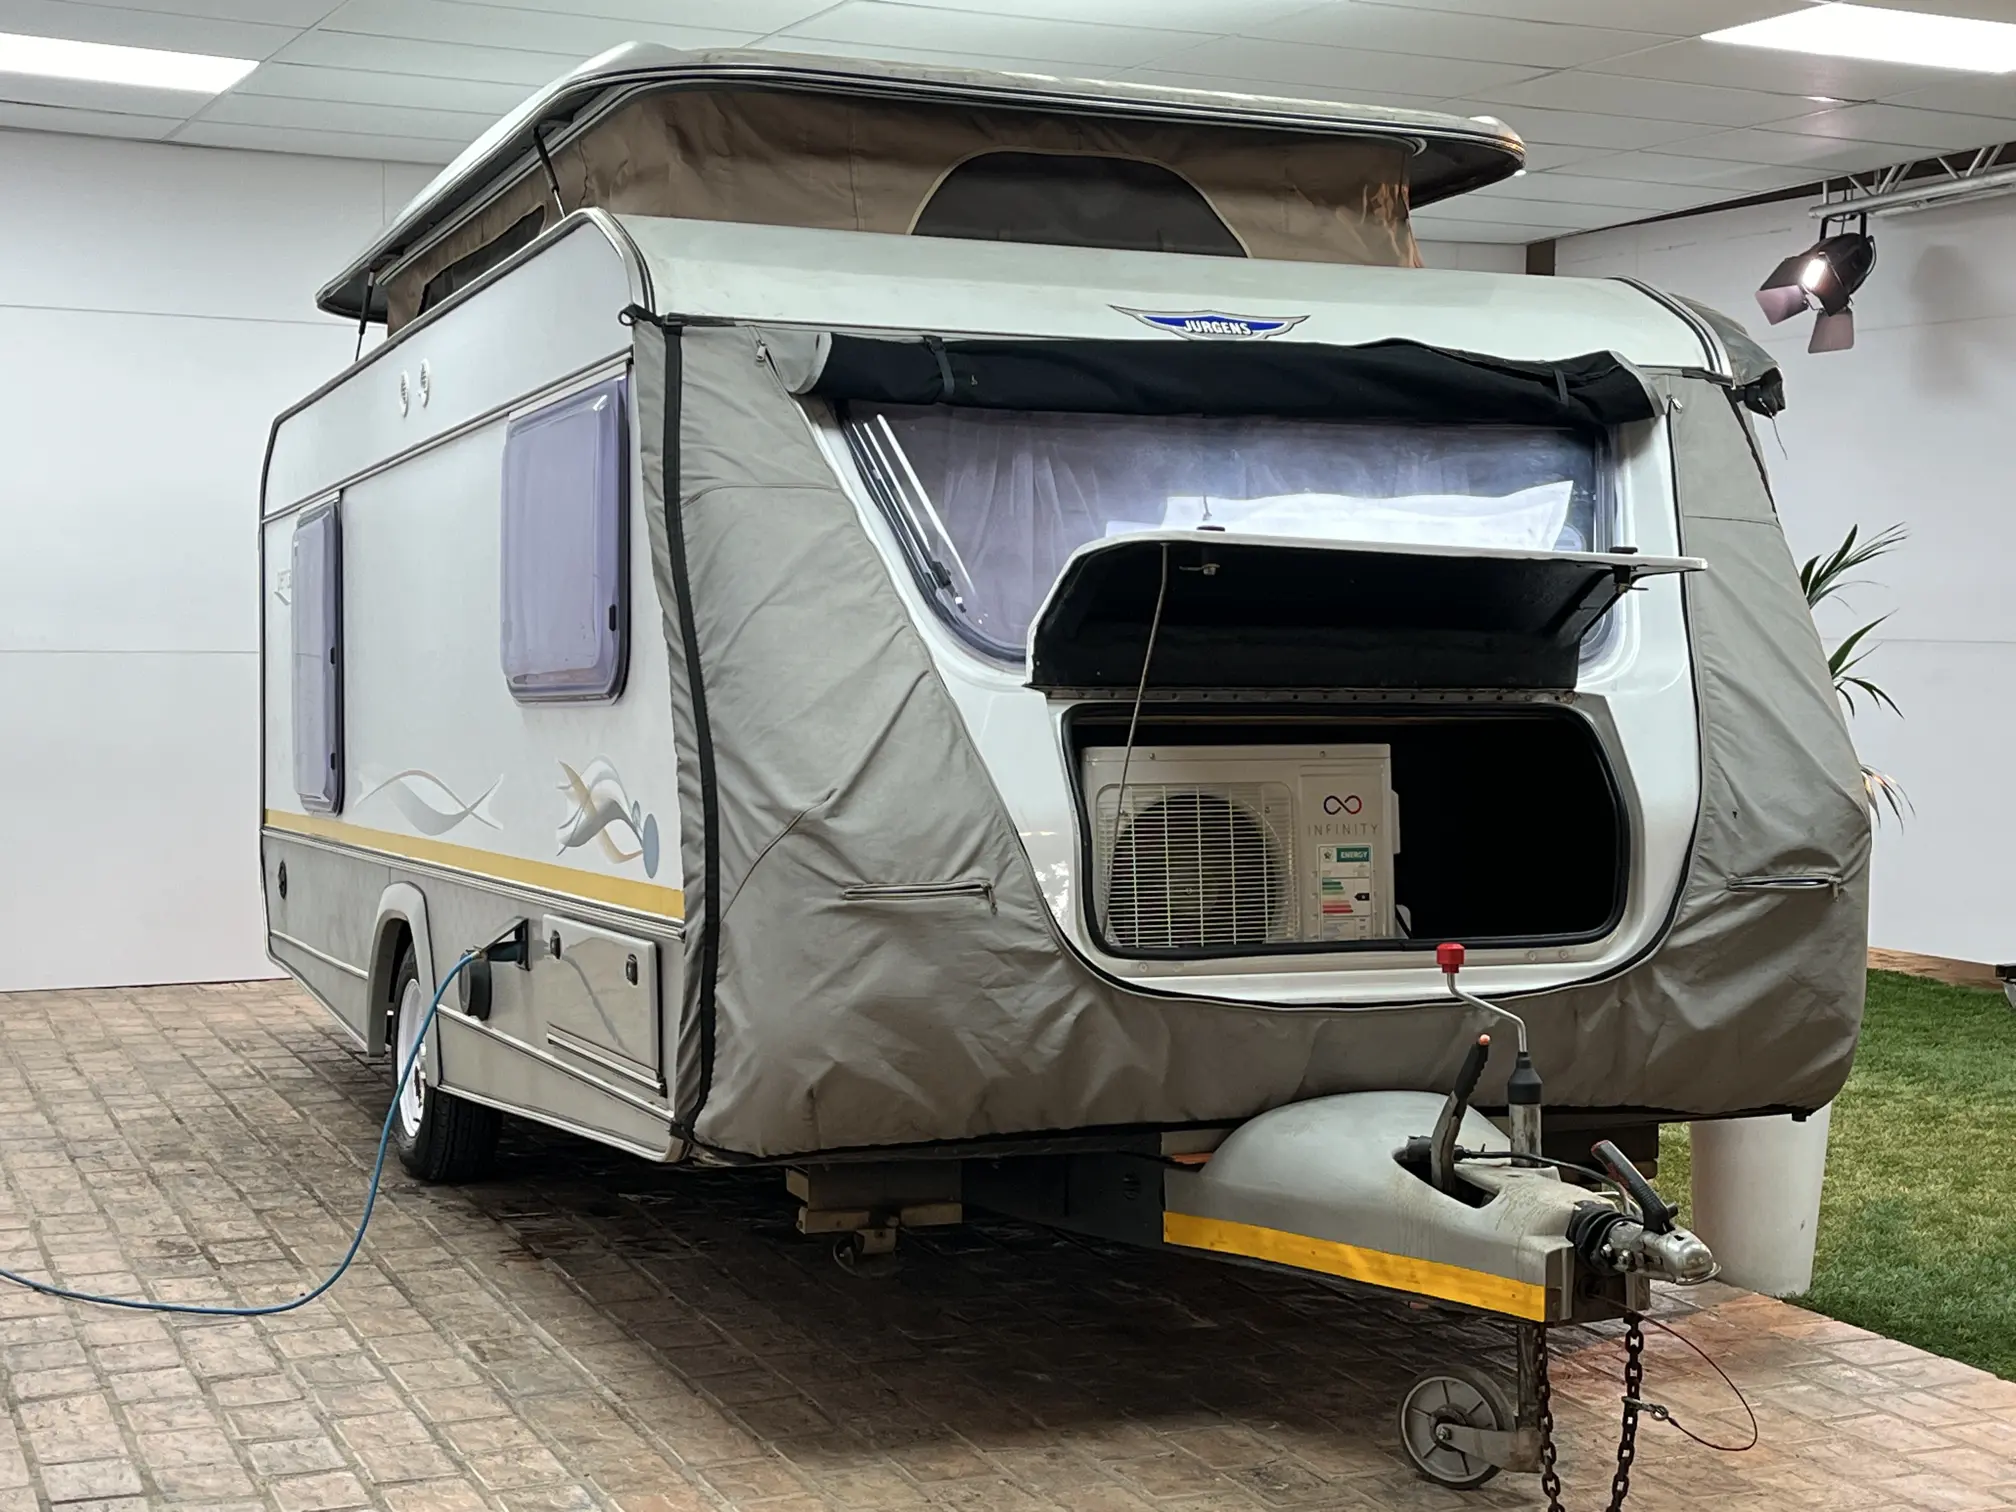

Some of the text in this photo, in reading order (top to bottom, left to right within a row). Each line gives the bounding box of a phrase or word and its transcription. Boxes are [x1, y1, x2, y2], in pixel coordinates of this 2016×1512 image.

[1183, 320, 1253, 335] JURGENS
[1307, 823, 1380, 837] INFINITY
[1340, 851, 1368, 859] ENERGY
